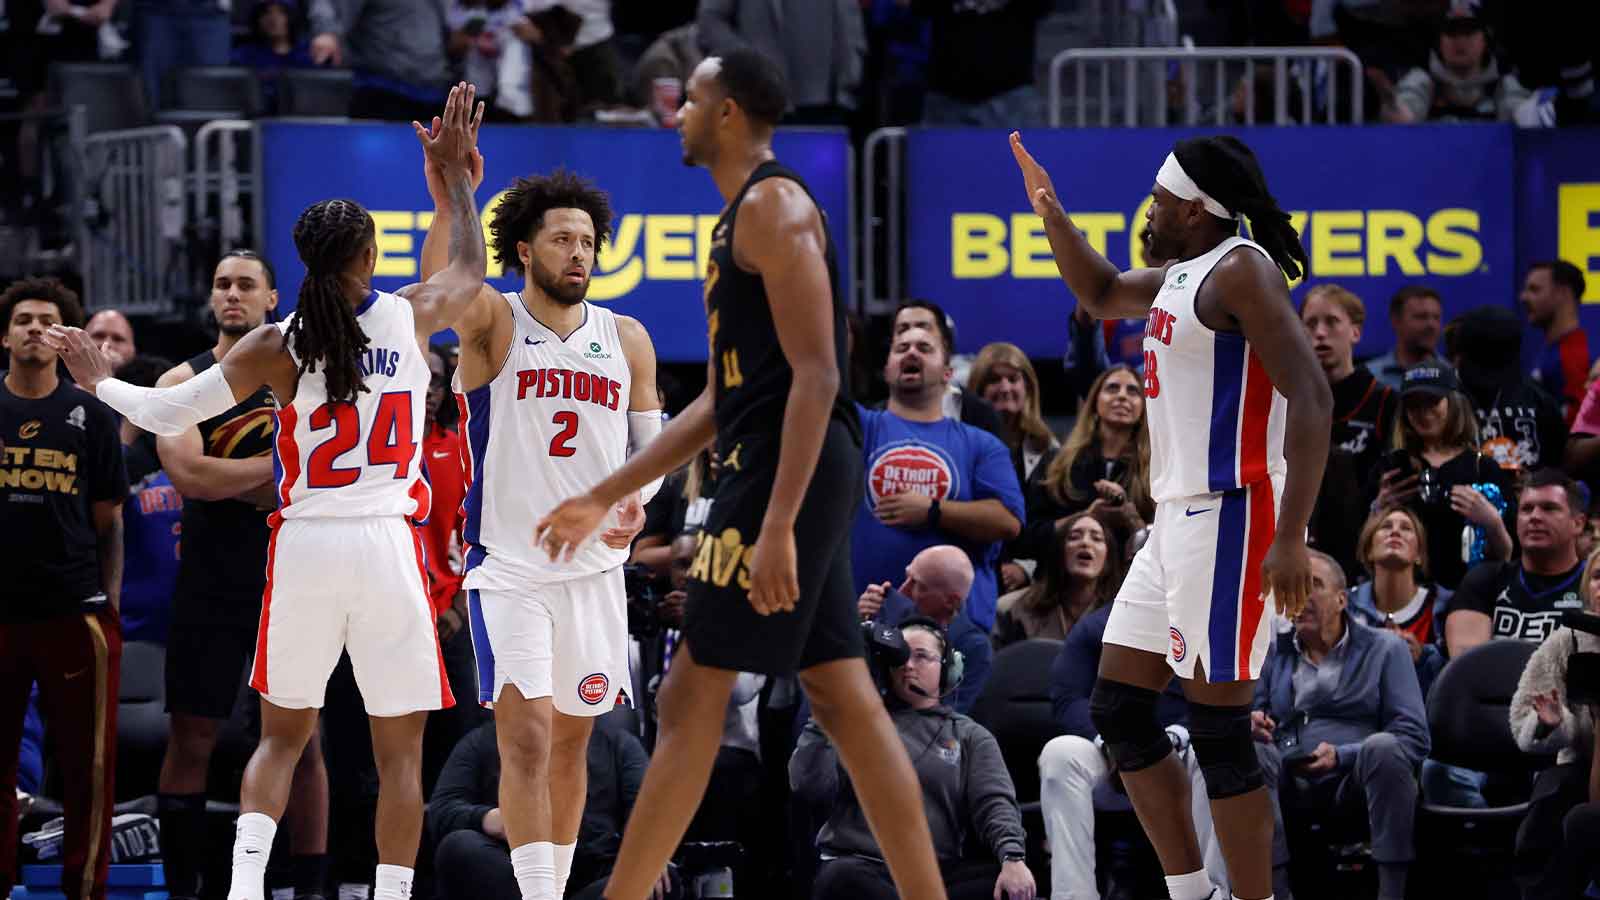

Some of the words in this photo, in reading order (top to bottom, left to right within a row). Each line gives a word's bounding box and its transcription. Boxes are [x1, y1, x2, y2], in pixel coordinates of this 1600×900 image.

[516, 368, 622, 411] PISTONS
[307, 391, 418, 488] 24
[549, 411, 579, 457] 2
[34, 447, 78, 473] EM
[883, 464, 940, 483] DETROIT
[882, 480, 939, 500] PIONS
[687, 529, 755, 590] AVS
